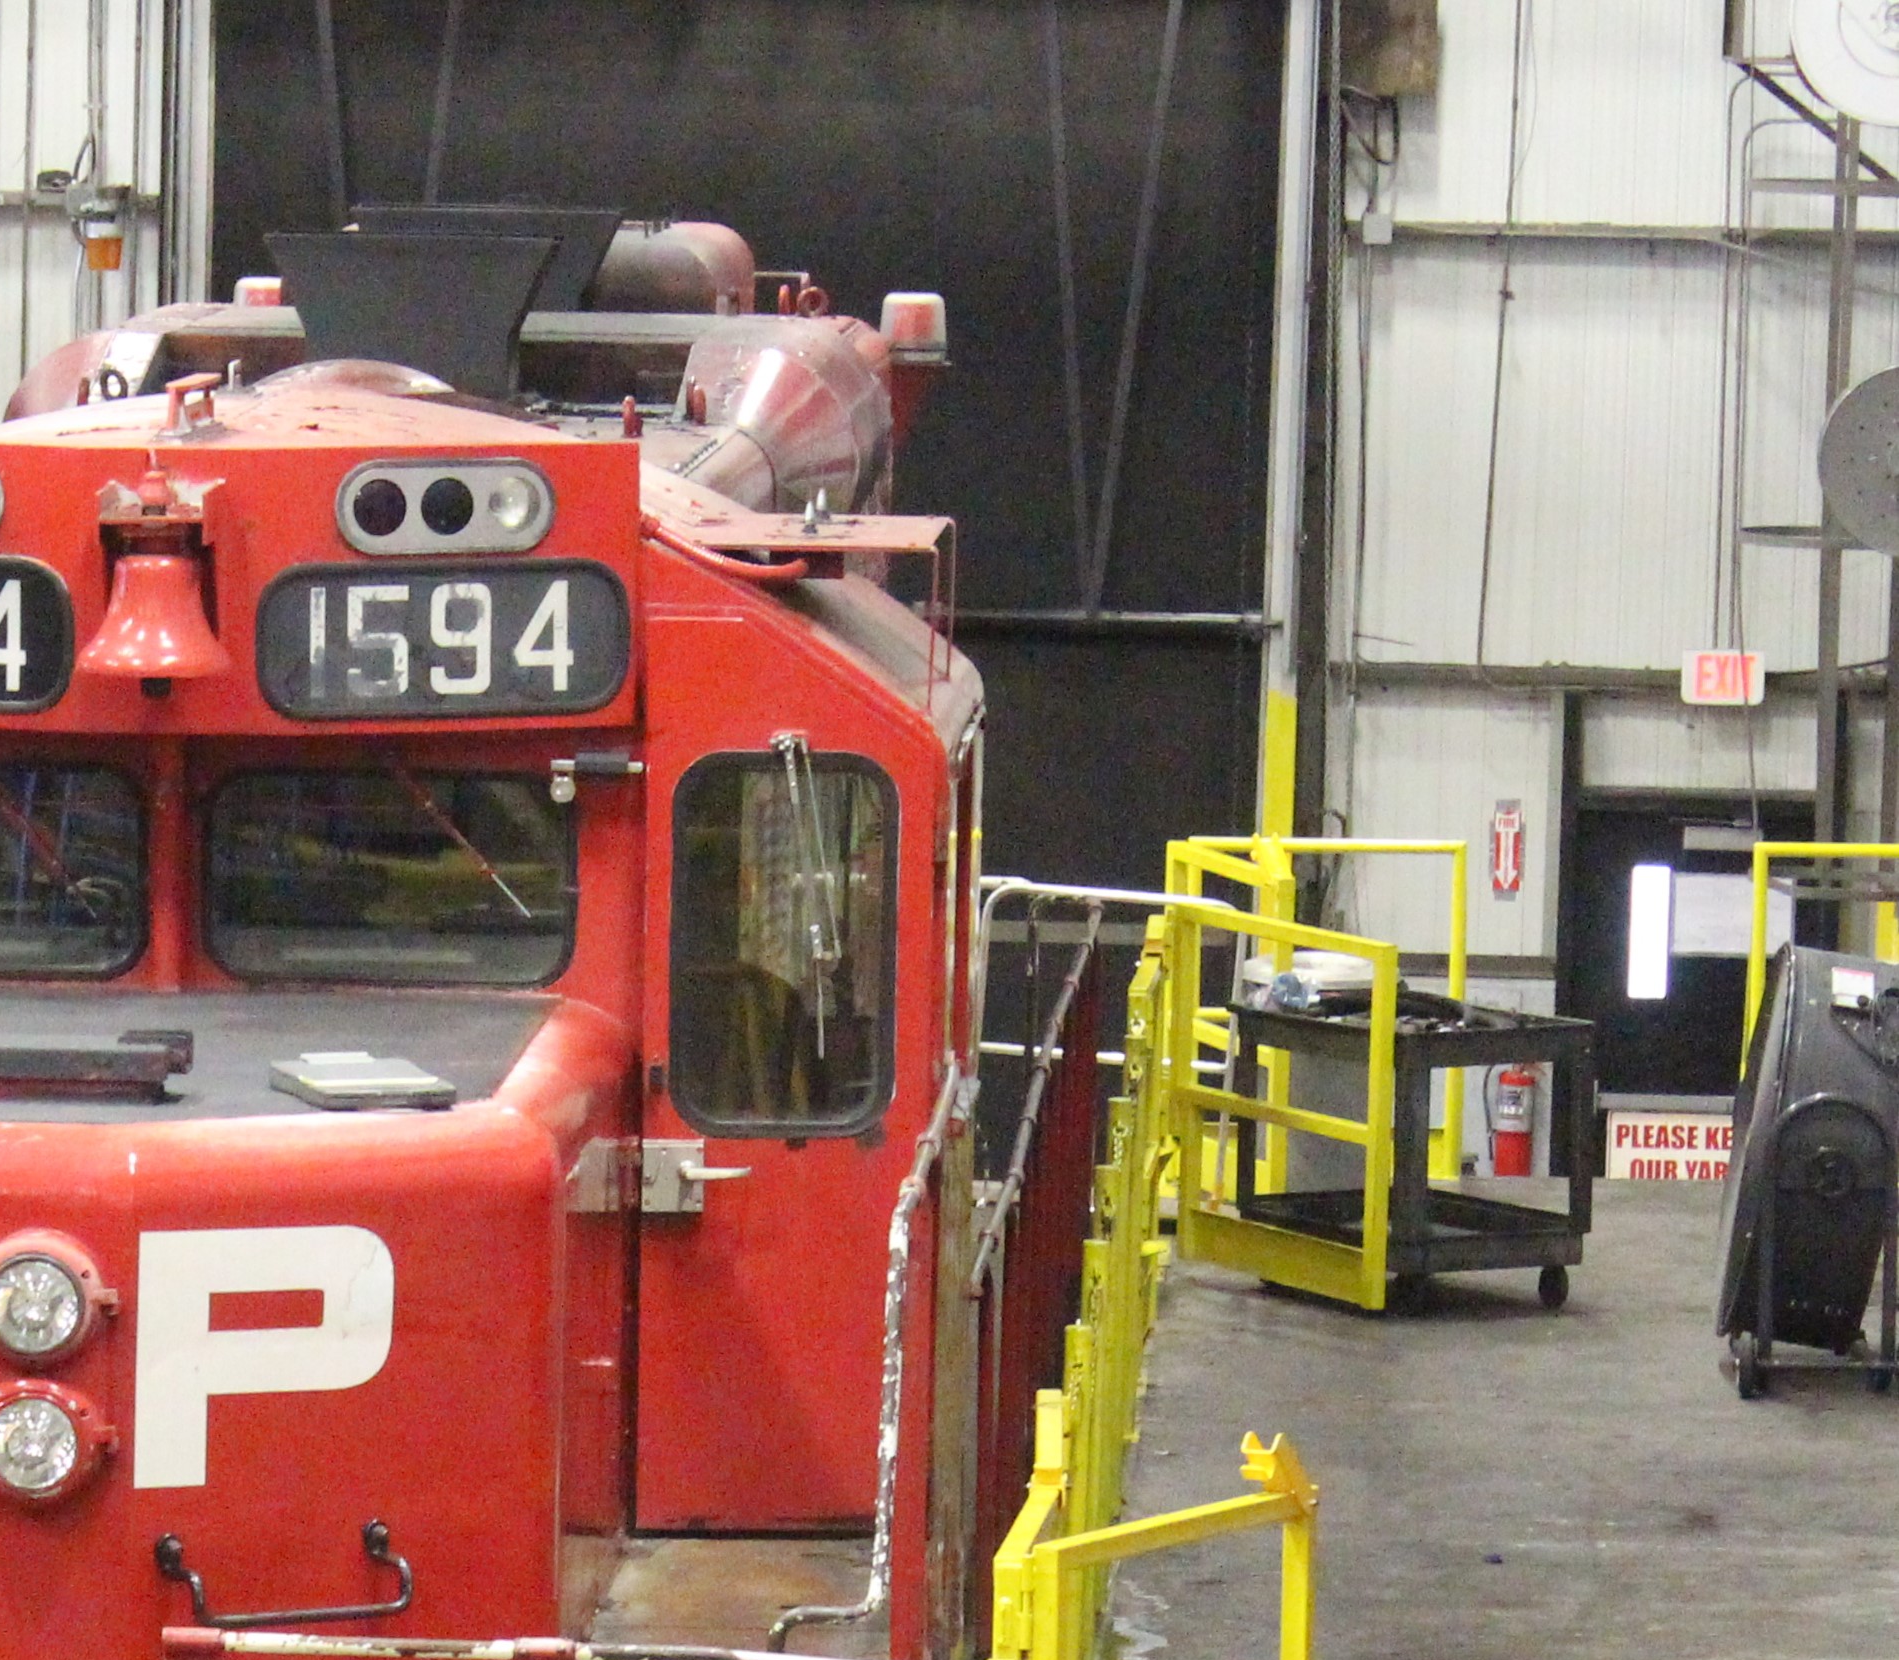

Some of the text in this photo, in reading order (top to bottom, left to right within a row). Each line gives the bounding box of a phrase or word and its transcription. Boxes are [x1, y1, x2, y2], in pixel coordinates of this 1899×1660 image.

[309, 578, 576, 698] 1594
[1694, 654, 1757, 699] EXIT
[1498, 817, 1516, 828] FIRE
[1616, 1124, 1734, 1149] PLEASE KE
[1630, 1158, 1731, 1180] OUR YAR
